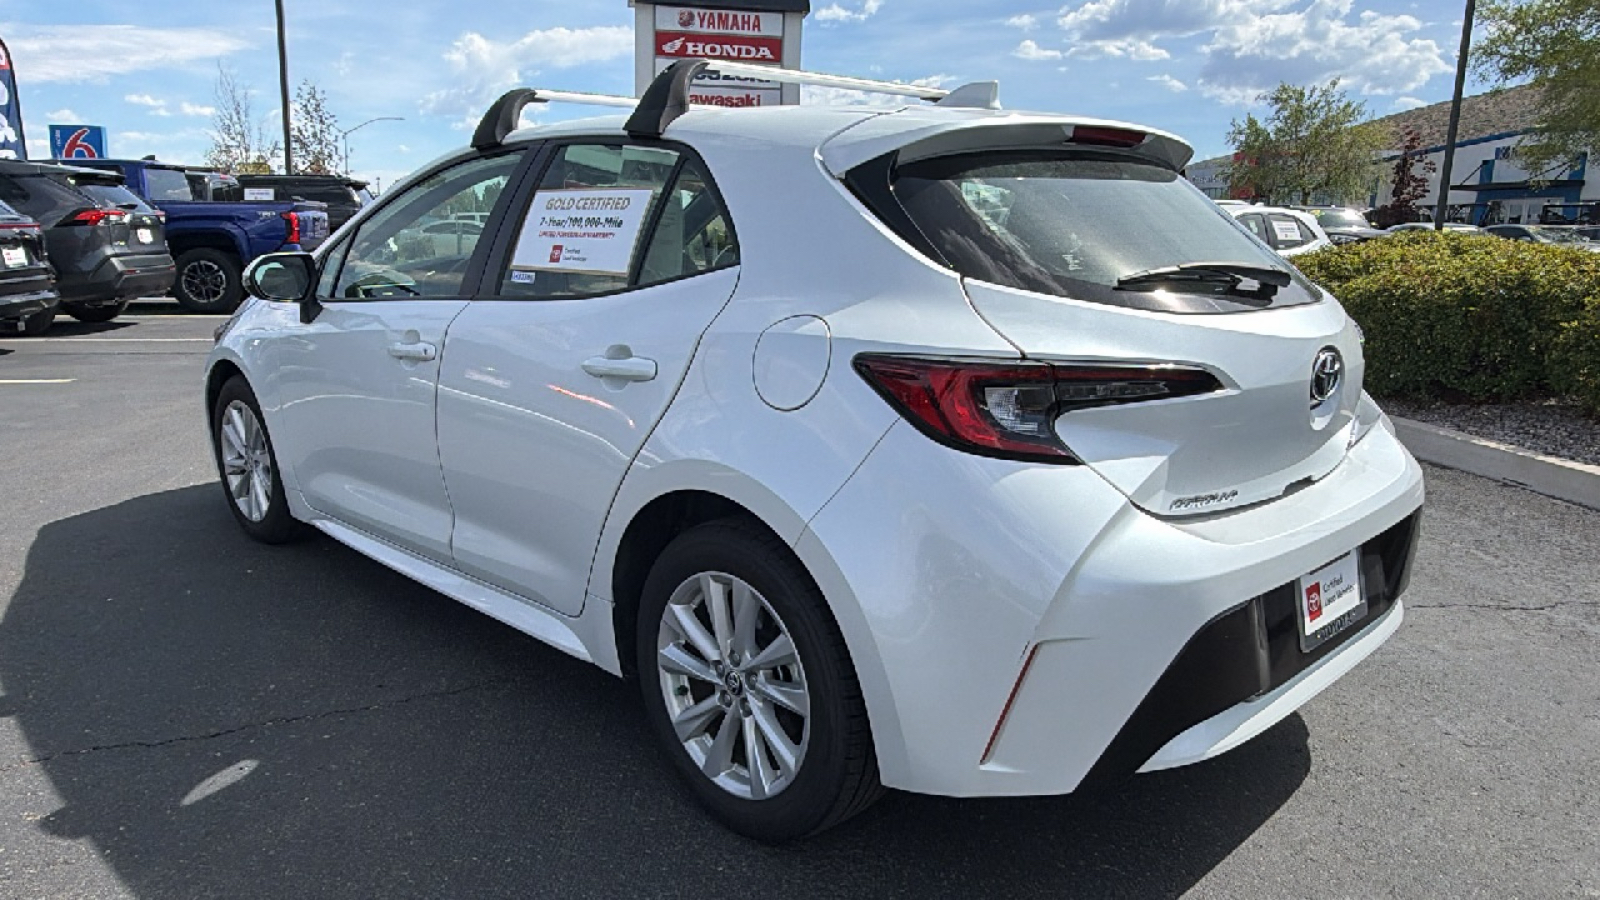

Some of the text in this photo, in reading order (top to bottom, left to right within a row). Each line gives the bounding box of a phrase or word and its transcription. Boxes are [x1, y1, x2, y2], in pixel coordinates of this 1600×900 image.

[697, 11, 762, 32] YAMAHA
[685, 42, 775, 59] HONDA
[689, 93, 761, 107] awasaki
[63, 128, 97, 159] 6
[545, 196, 631, 211] GOLD CERTIFIED
